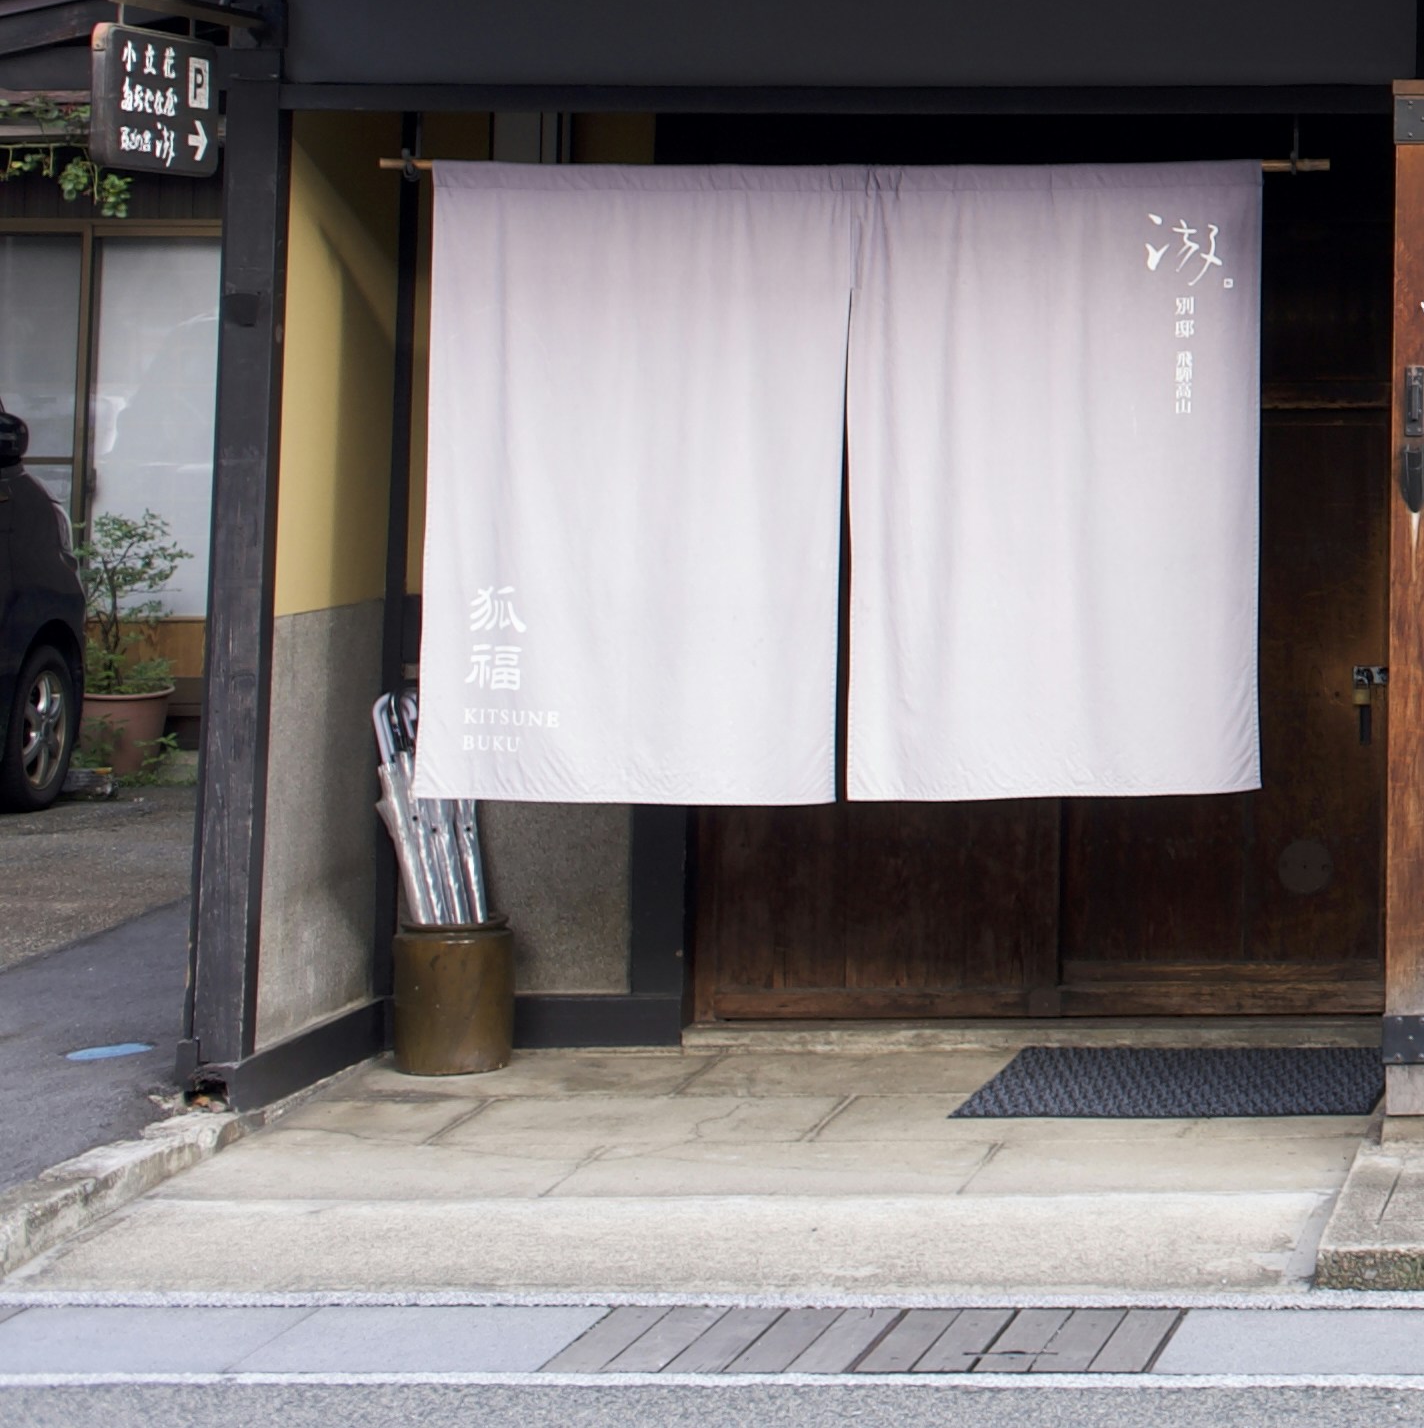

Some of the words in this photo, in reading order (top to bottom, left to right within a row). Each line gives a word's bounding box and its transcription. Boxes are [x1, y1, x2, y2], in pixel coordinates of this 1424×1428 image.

[464, 585, 528, 692] 狐福
[463, 707, 561, 729] KITSUNE
[462, 734, 521, 752] BUKU
